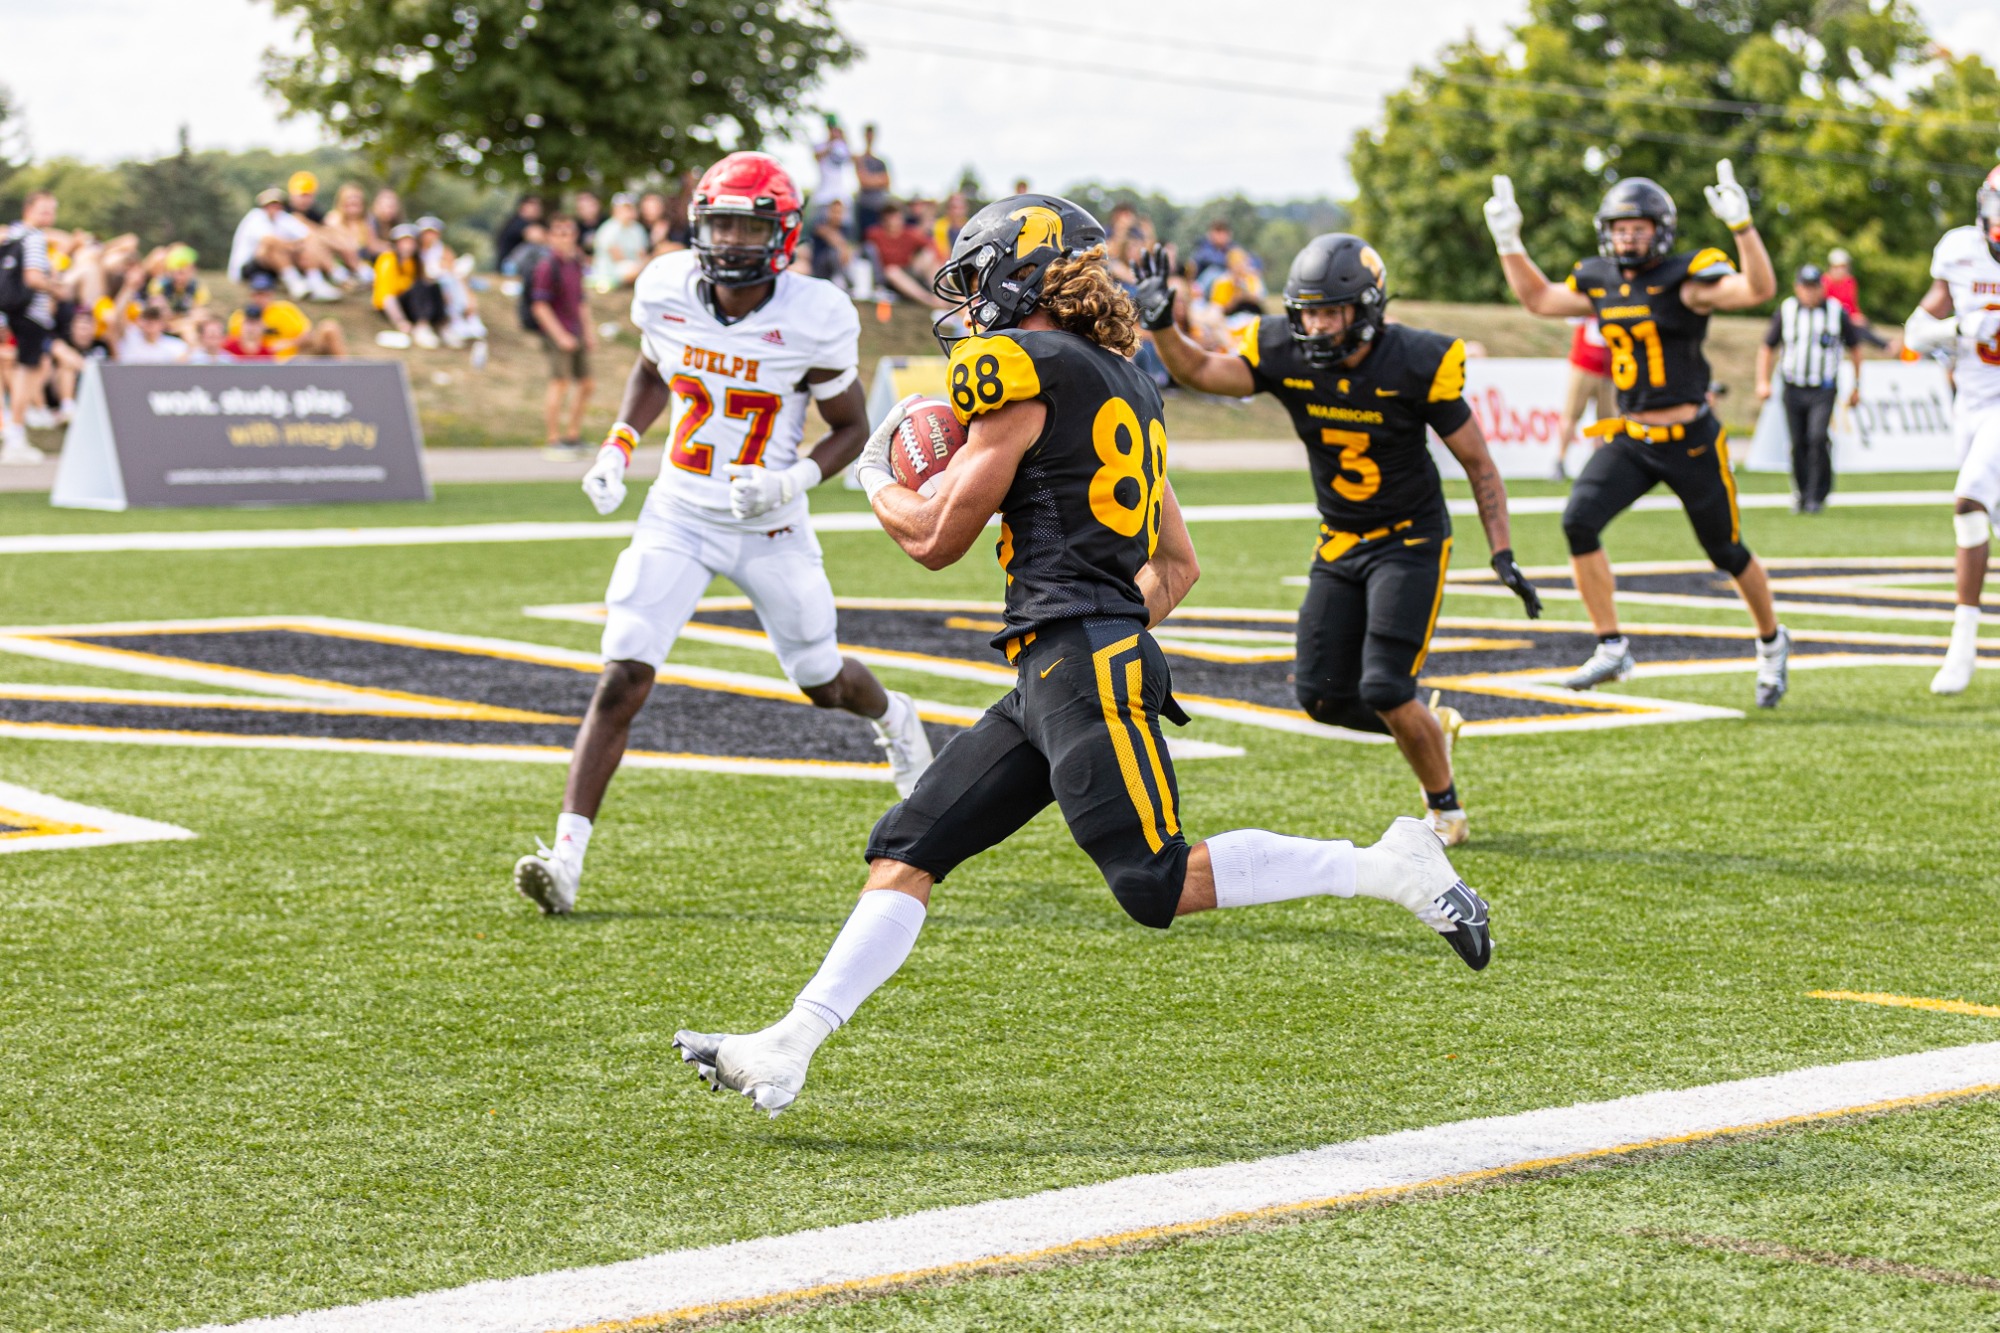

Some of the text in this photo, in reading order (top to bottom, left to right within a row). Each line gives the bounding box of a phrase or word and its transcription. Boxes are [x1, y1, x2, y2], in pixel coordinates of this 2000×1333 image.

[683, 345, 760, 382] GUELPH
[952, 354, 1004, 412] 88
[1600, 320, 1666, 391] 81
[668, 373, 782, 481] 27
[925, 412, 949, 460] Wilson
[1306, 403, 1384, 425] WARRIORS
[1088, 396, 1167, 559] 88
[1321, 428, 1382, 501] 3
